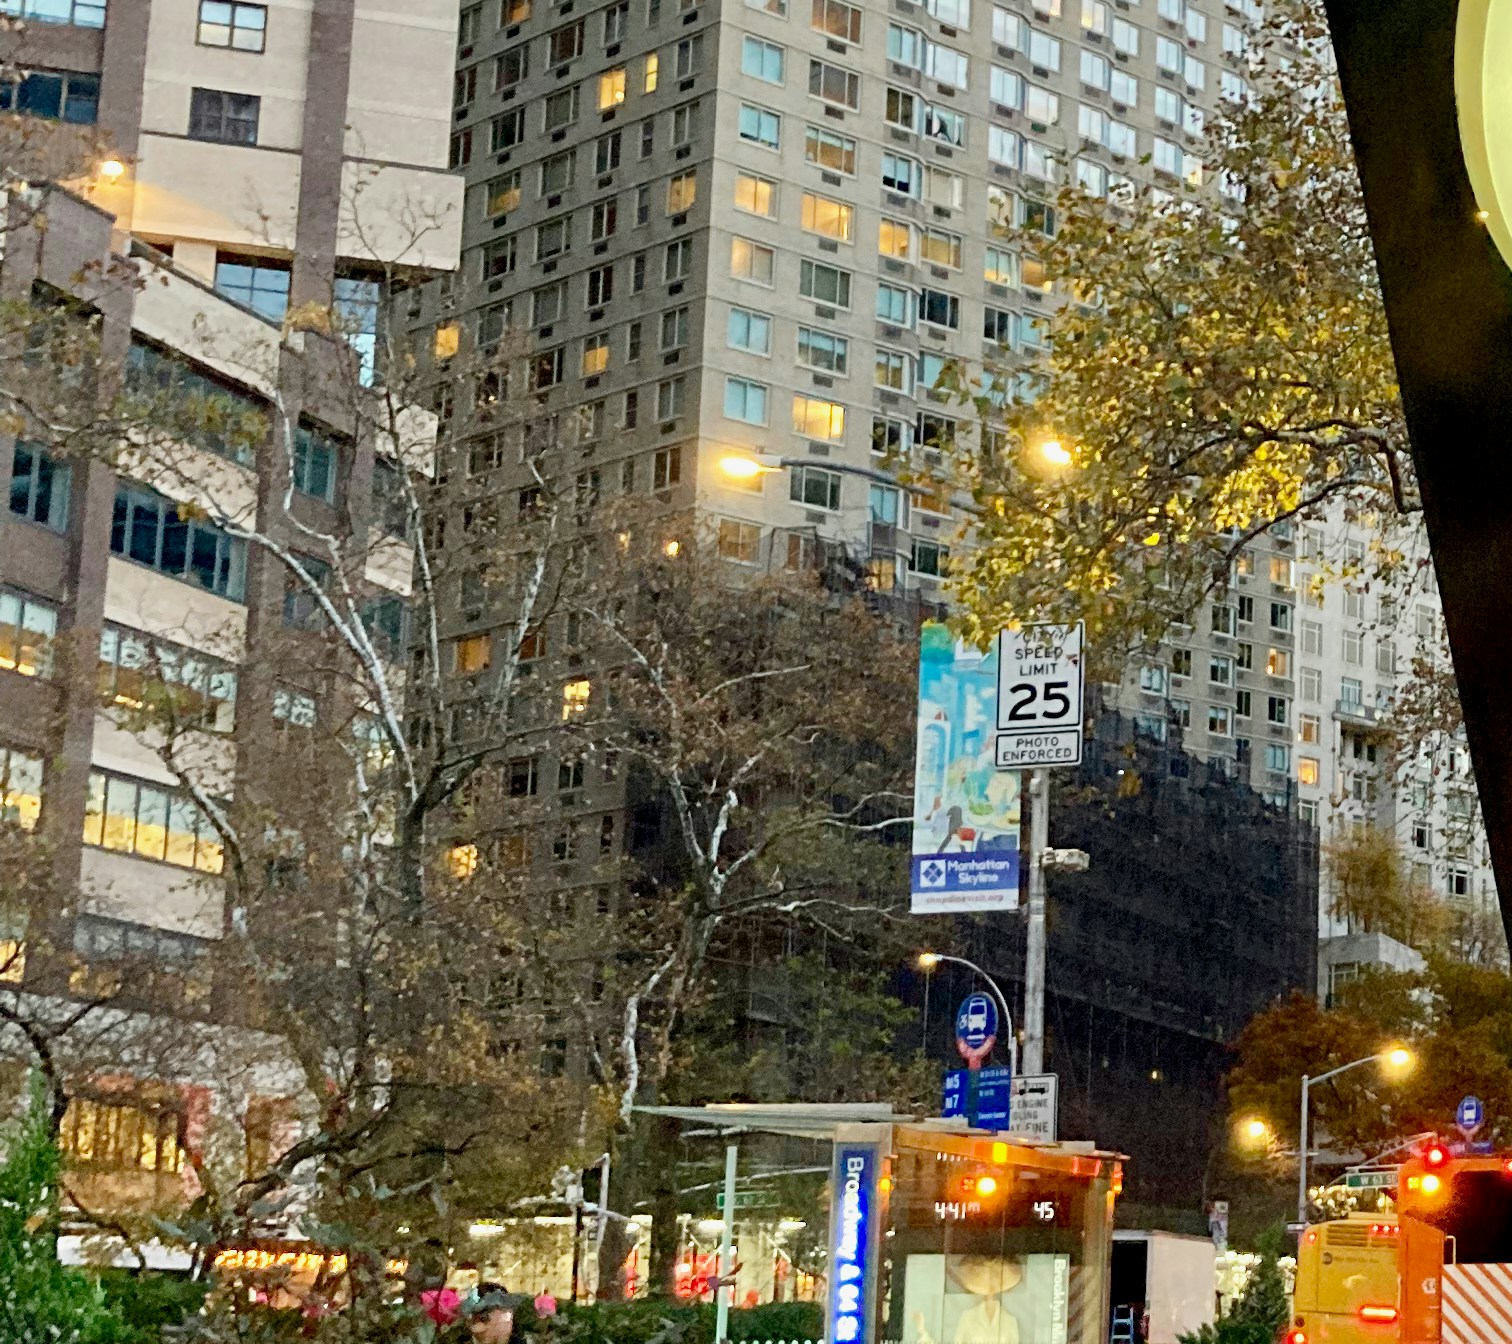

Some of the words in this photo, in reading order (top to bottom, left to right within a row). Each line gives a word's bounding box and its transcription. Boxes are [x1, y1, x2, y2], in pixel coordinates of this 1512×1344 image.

[1015, 646, 1063, 660] SPEED
[1020, 663, 1058, 676] LIMIT
[1008, 681, 1070, 721] 25
[1016, 737, 1059, 748] PHOTO
[1003, 748, 1072, 762] ENFORCED
[947, 859, 1010, 872] Manhattan
[958, 872, 999, 886] Skyline
[1018, 1098, 1049, 1109] ENGINE
[1026, 1122, 1049, 1133] FINE
[1361, 1177, 1370, 1186] W
[835, 1156, 865, 1261] Broadway
[1050, 1258, 1067, 1322] Brooklyn
